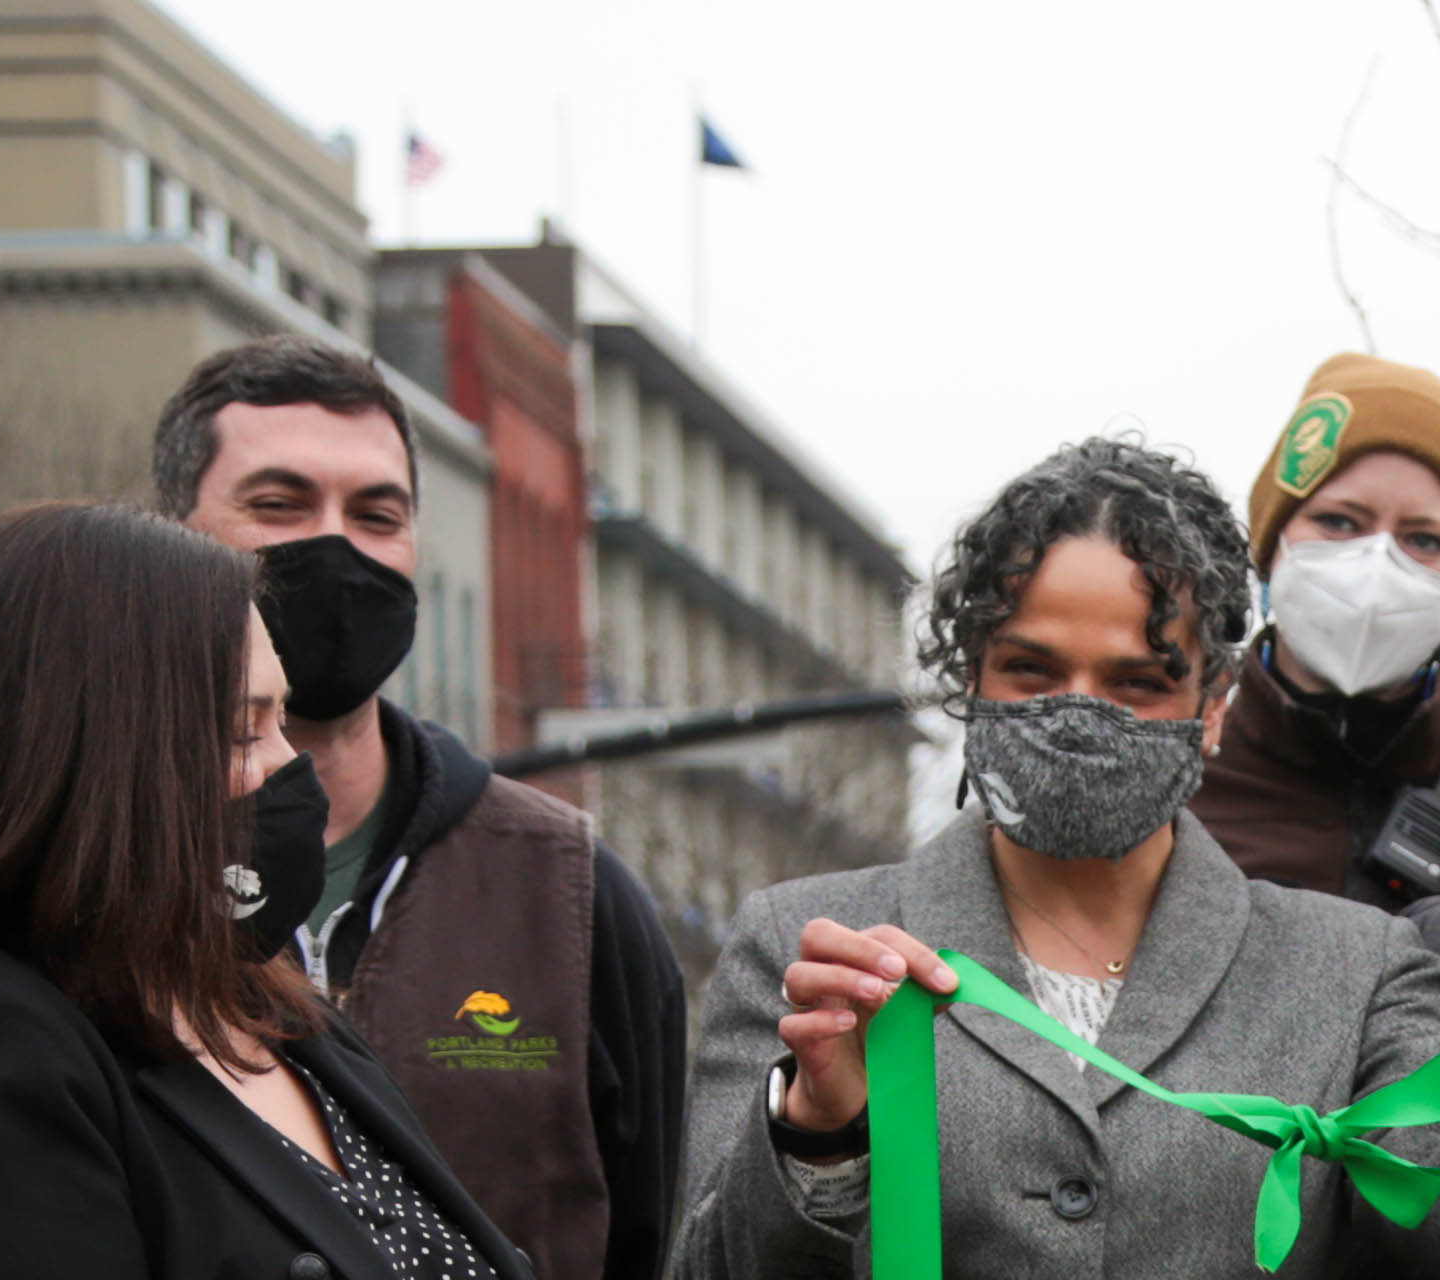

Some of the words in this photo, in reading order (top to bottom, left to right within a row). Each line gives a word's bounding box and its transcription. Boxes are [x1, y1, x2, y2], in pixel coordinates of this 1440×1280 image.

[427, 1036, 504, 1050] PORTLAND
[511, 1036, 557, 1050] PARKS
[462, 1056, 548, 1070] RECREATION
